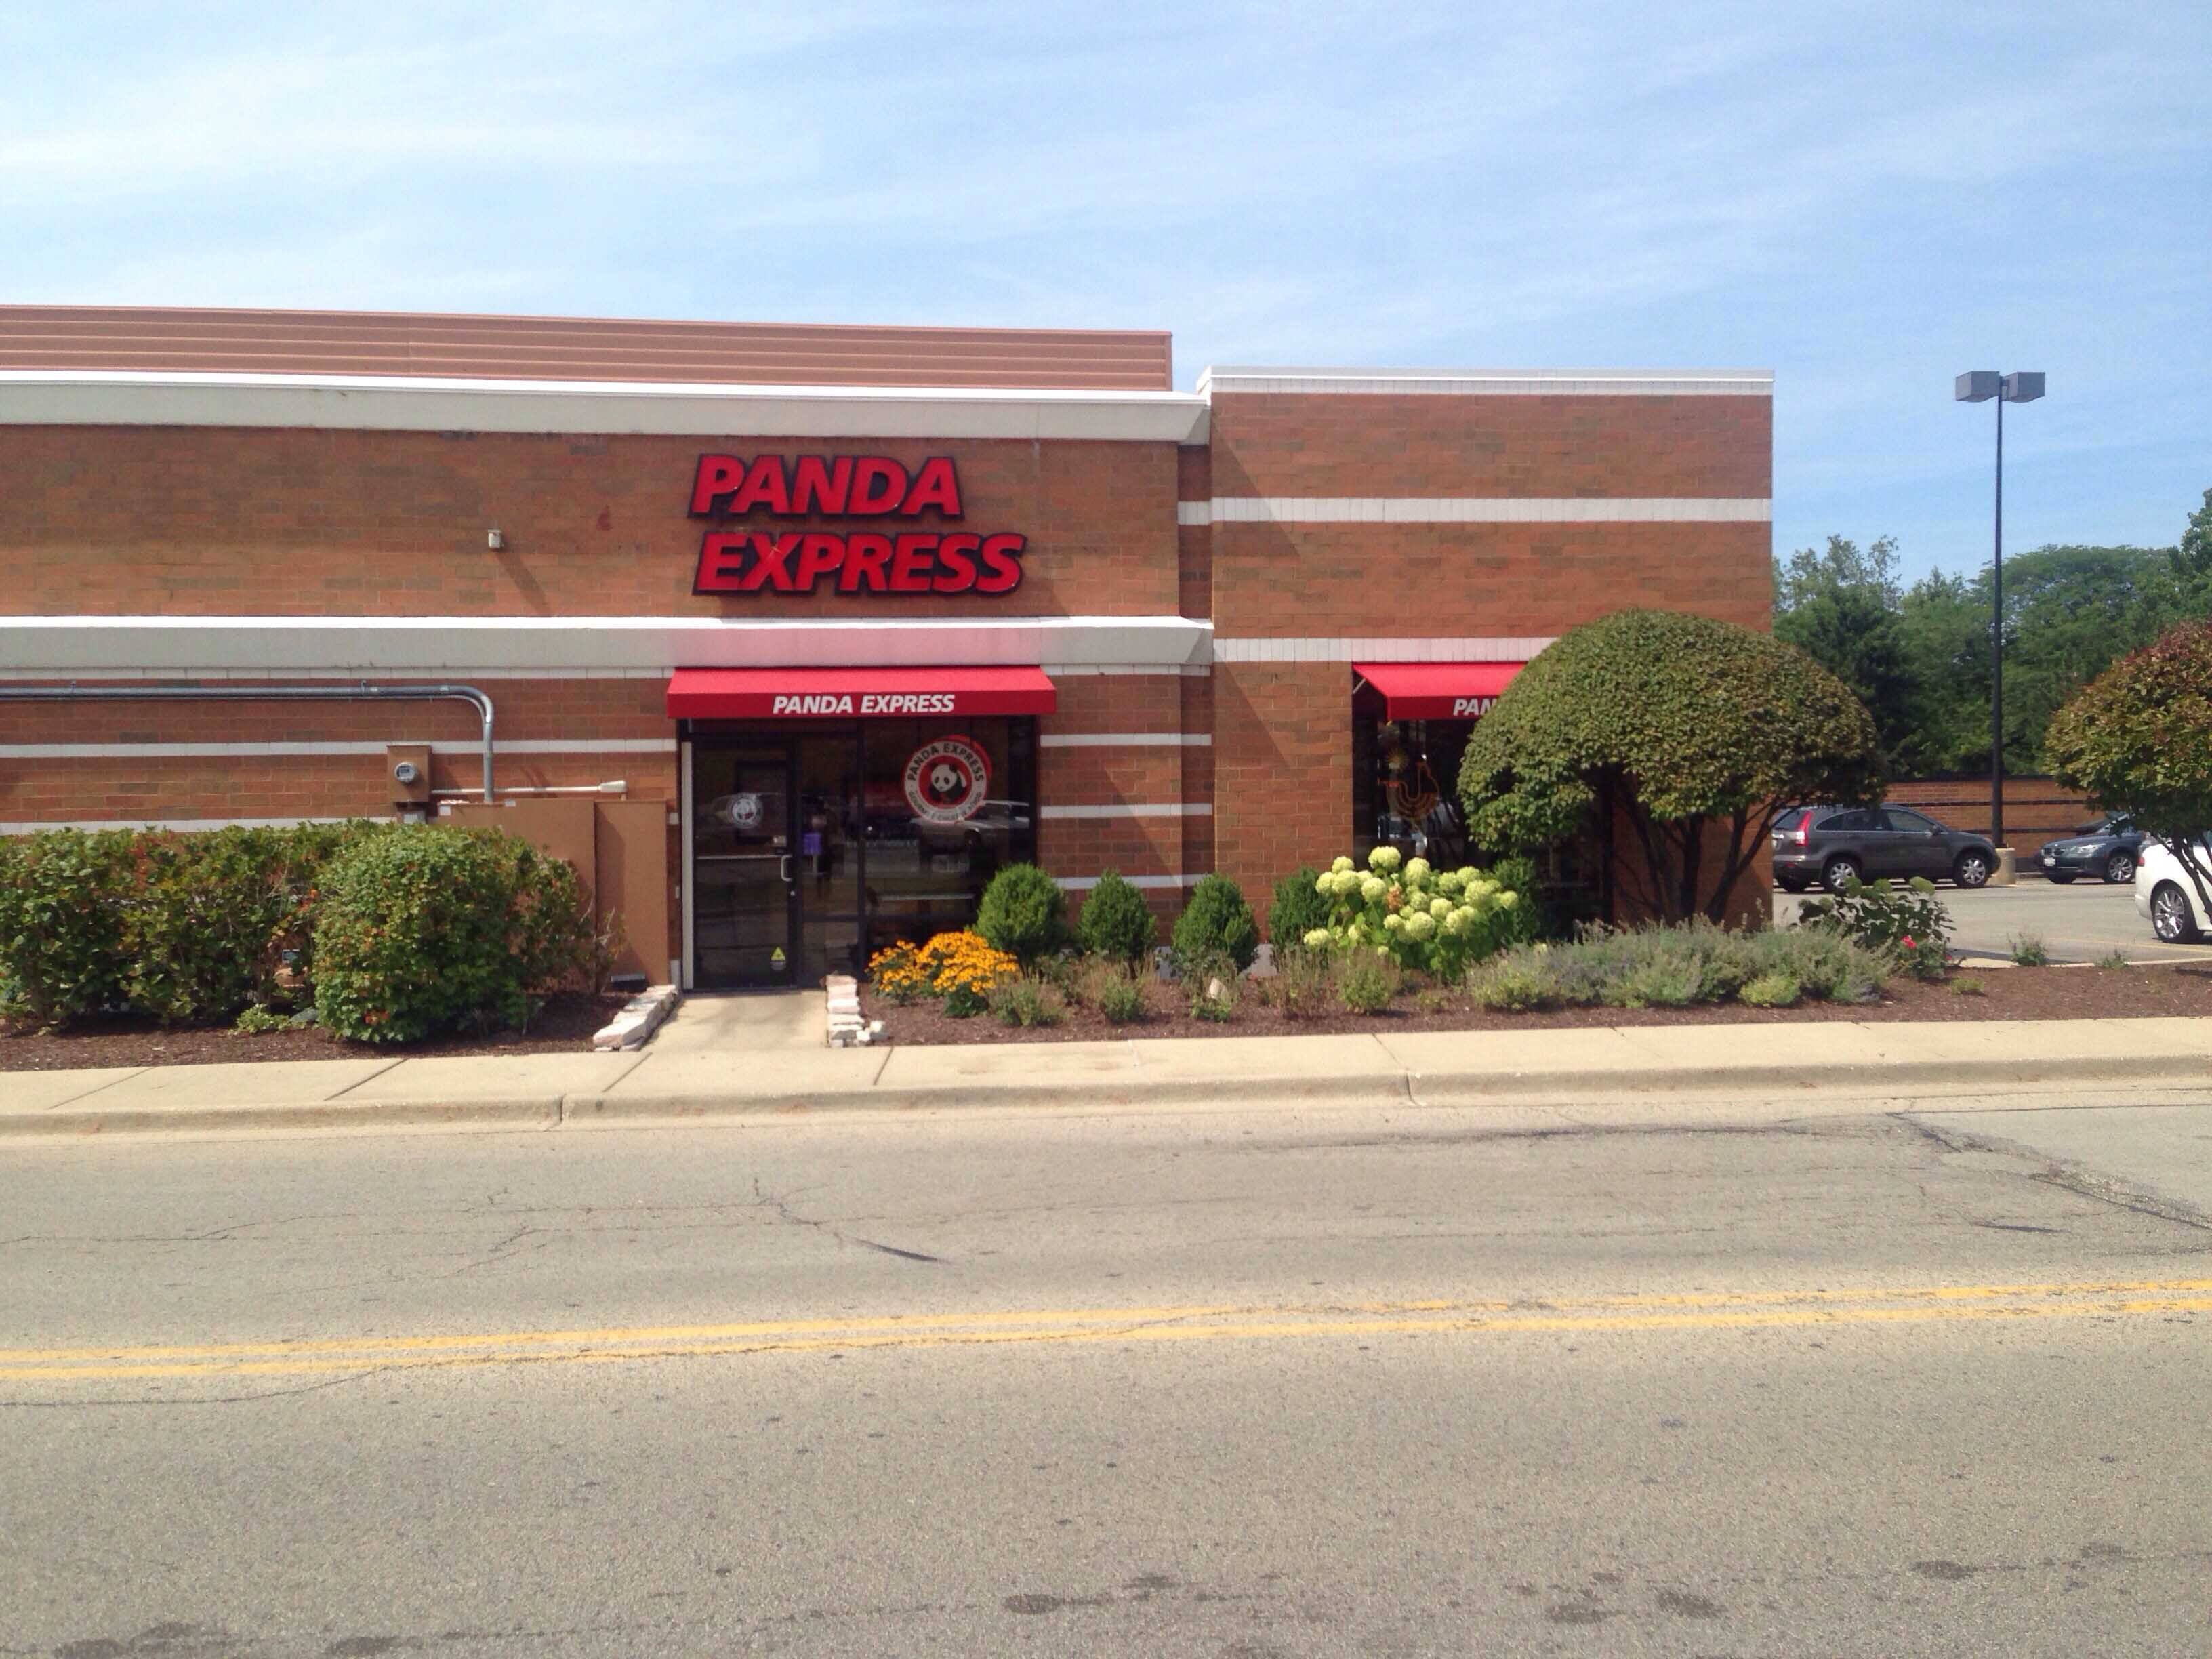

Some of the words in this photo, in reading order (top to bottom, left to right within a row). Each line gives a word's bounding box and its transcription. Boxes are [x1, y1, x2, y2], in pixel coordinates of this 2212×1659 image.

[689, 453, 964, 518] PANDA
[693, 531, 1026, 595] EXPRESS
[773, 695, 853, 714] PANDA
[860, 694, 955, 713] EXPRESS
[907, 745, 939, 781] PANDA
[943, 743, 984, 781] EXPRESS
